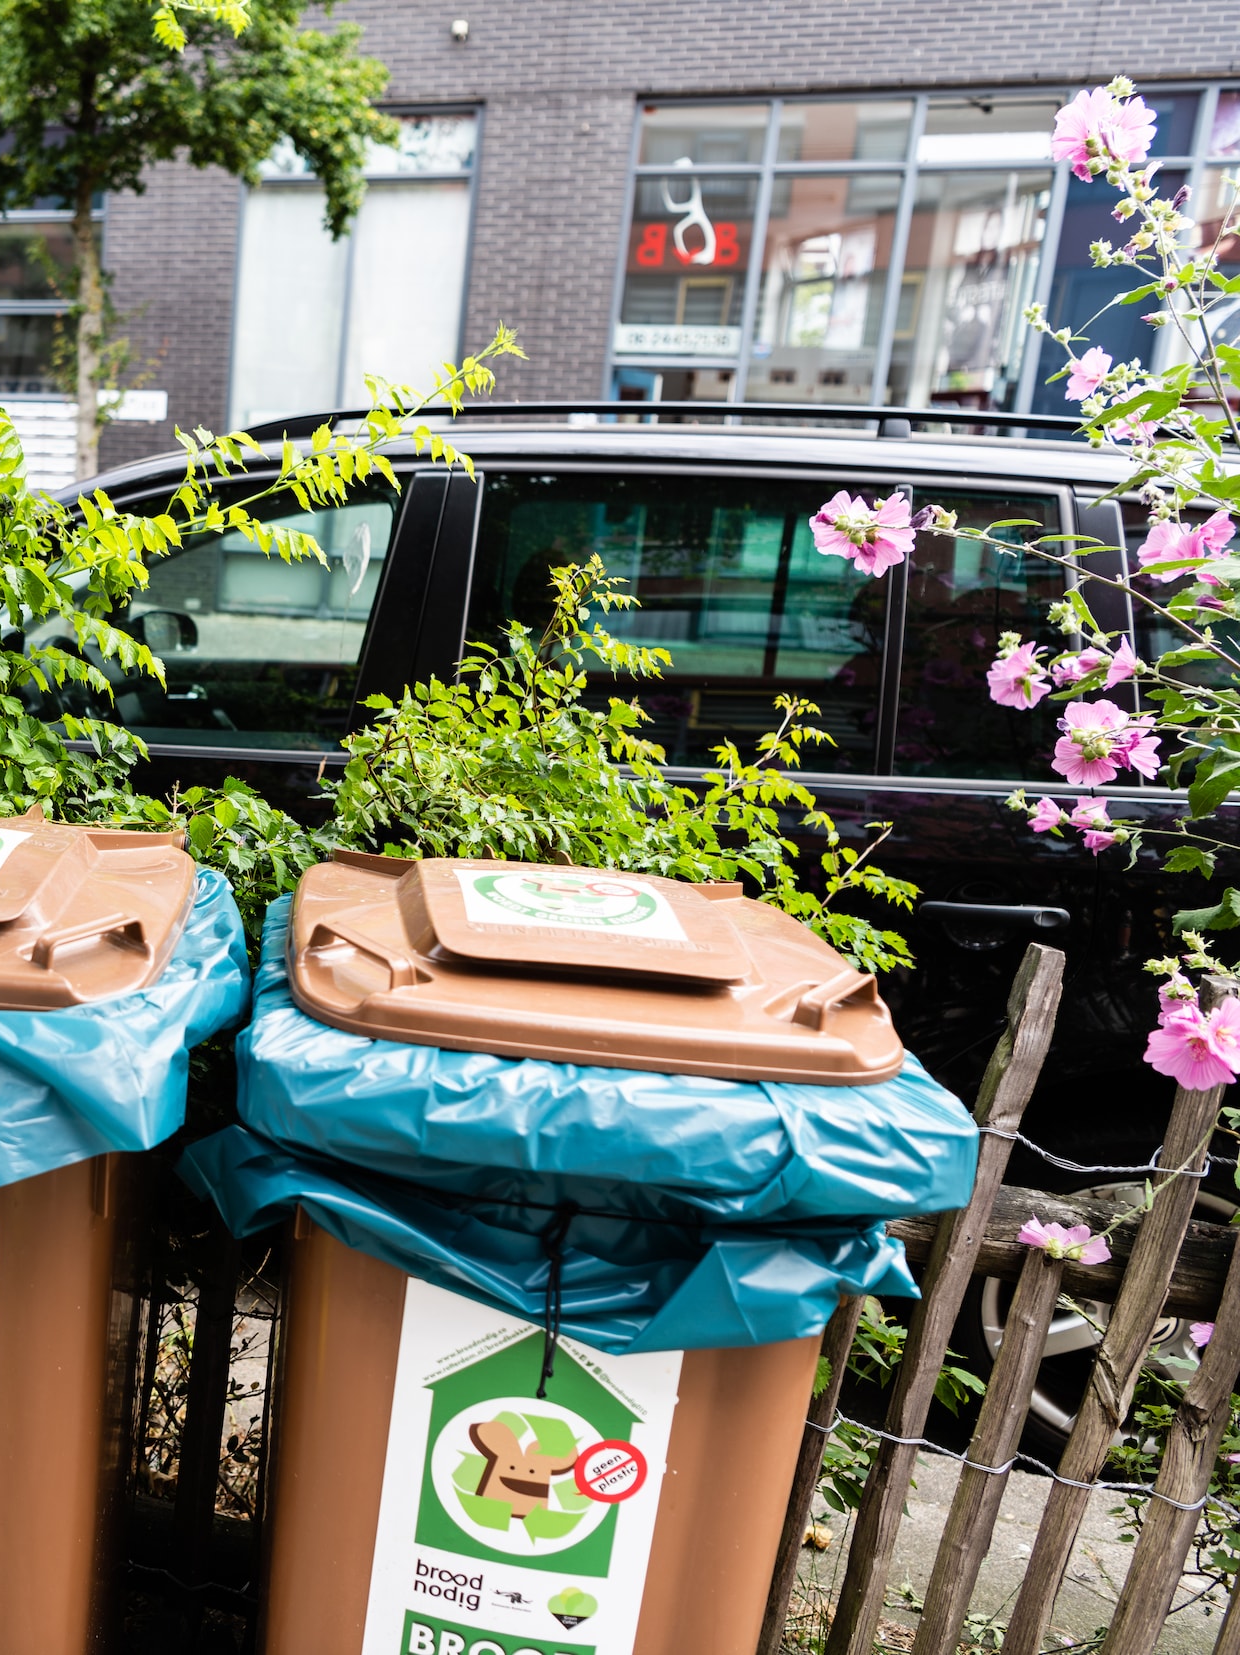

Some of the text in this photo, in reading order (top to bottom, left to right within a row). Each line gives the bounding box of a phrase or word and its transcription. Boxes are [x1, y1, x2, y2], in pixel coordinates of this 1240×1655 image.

[592, 1454, 622, 1475] geen
[598, 1464, 638, 1492] plastic
[416, 1558, 483, 1590] brood
